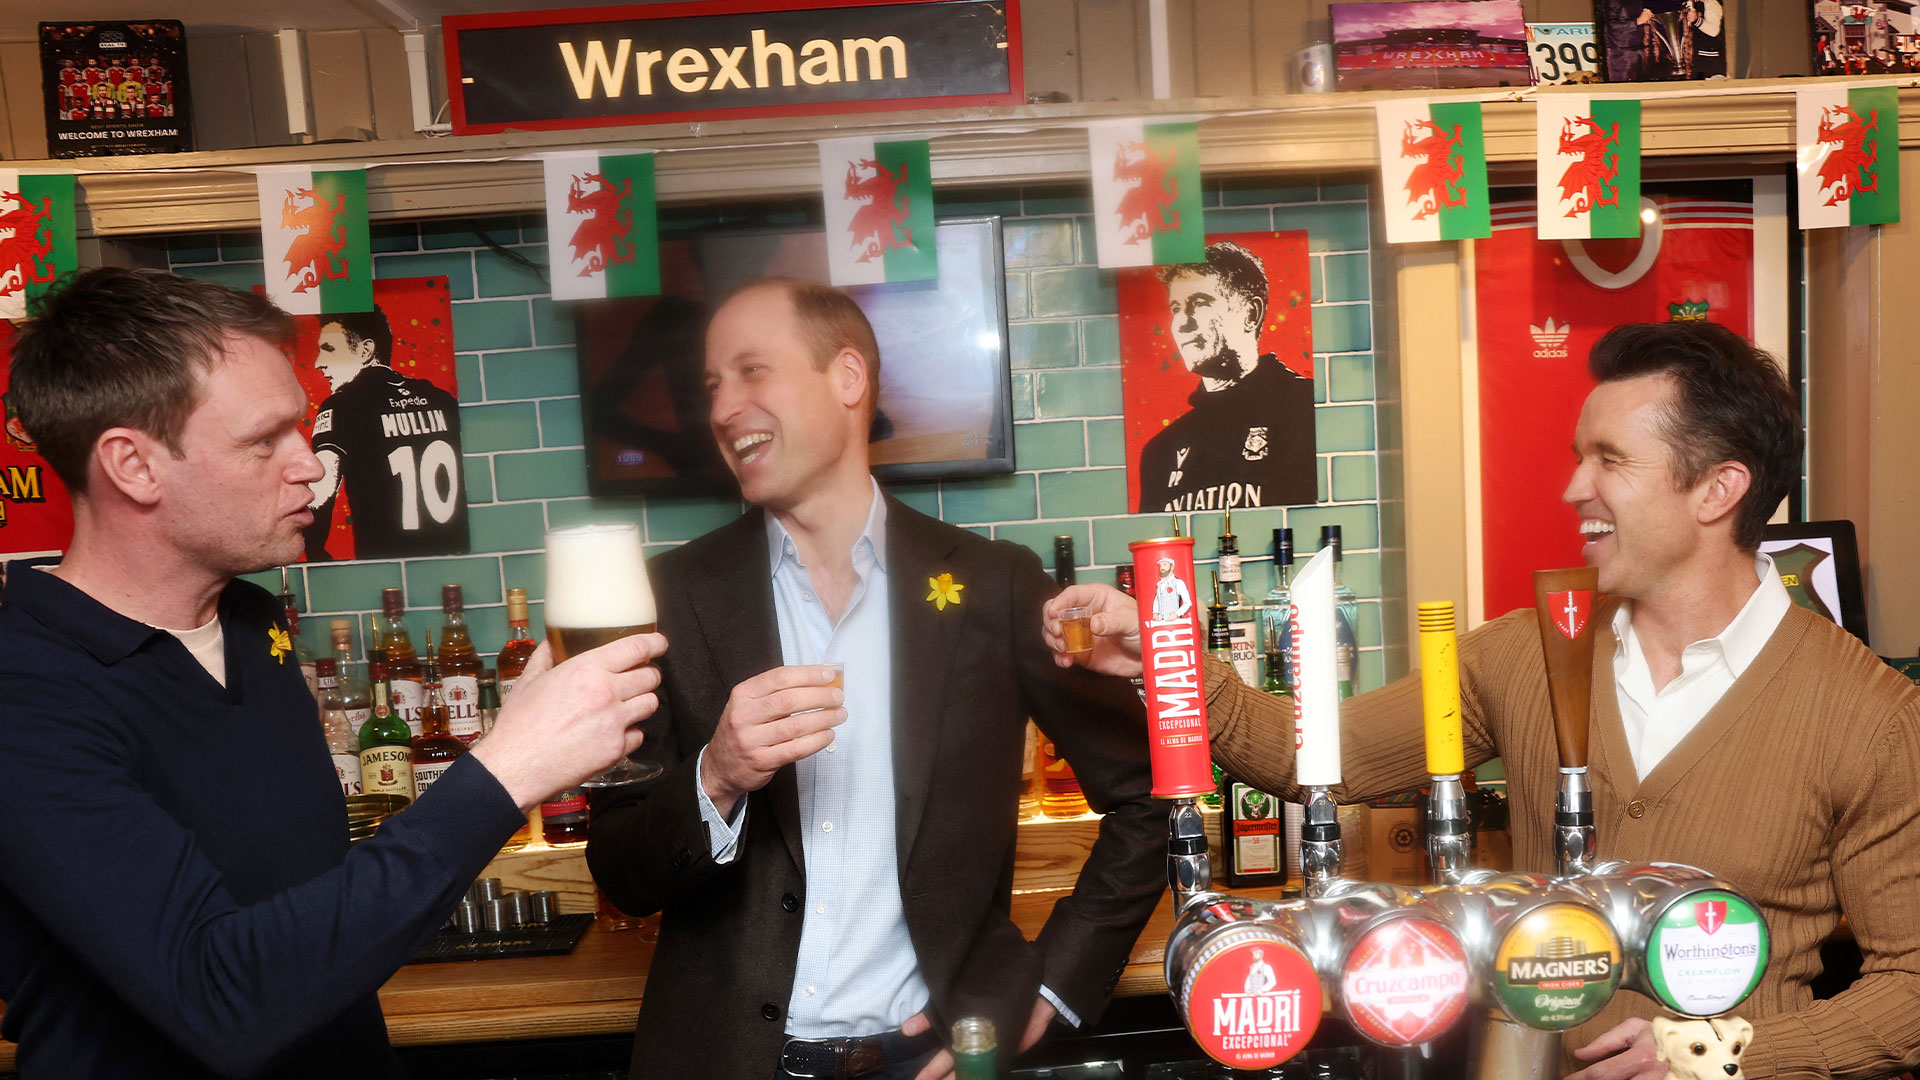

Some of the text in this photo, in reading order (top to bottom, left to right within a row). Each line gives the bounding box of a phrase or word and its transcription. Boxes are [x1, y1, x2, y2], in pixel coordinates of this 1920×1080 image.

[559, 29, 908, 99] Wrexham
[1383, 50, 1485, 60] WREXHAM
[58, 128, 178, 141] WELCOME TO WREXHAM
[1533, 347, 1569, 359] adidas
[388, 396, 429, 410] Expedia
[380, 409, 449, 438] MULLIN
[387, 439, 458, 531] 10
[1159, 717, 1202, 730] EXCEPCIONAL
[362, 751, 410, 767] JAMESON
[1664, 942, 1757, 962] Worthington's
[1510, 957, 1610, 980] MAGNERS
[1678, 968, 1741, 977] CREAMFLOW
[1355, 971, 1461, 994] Cruzcampo
[1534, 993, 1586, 1012] Original
[1212, 989, 1302, 1036] MADRÍ
[1222, 1033, 1289, 1050] EXCEPCIONAL
